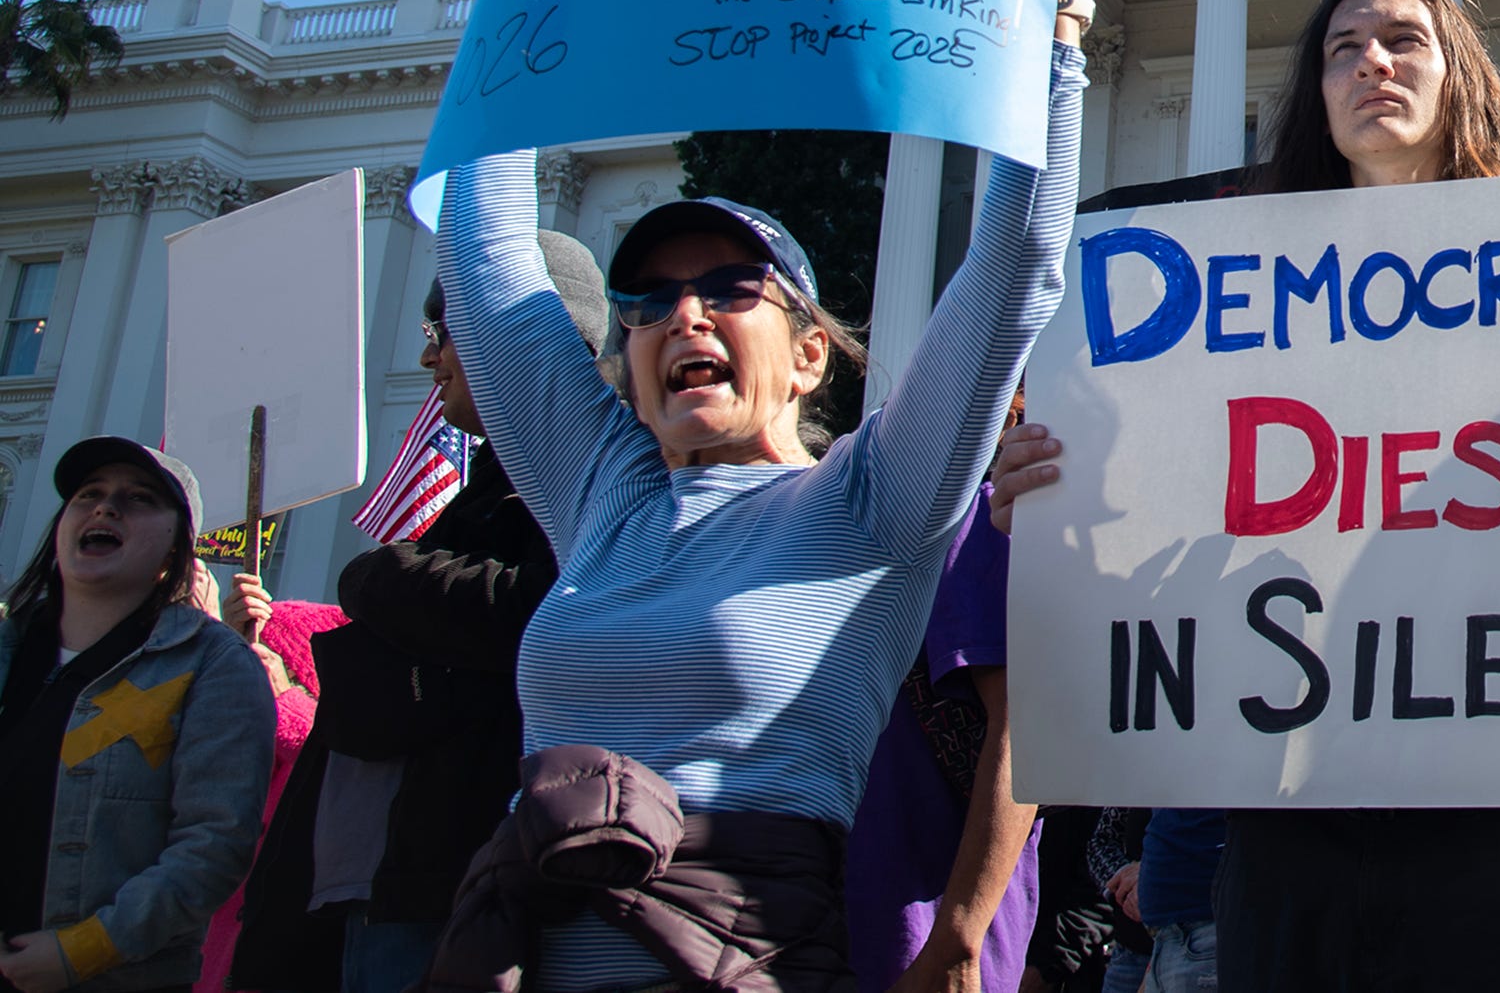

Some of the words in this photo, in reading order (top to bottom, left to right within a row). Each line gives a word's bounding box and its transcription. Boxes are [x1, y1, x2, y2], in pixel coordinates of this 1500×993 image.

[456, 5, 568, 105] 026
[669, 25, 770, 66] STOP
[1109, 617, 1196, 733] IN
